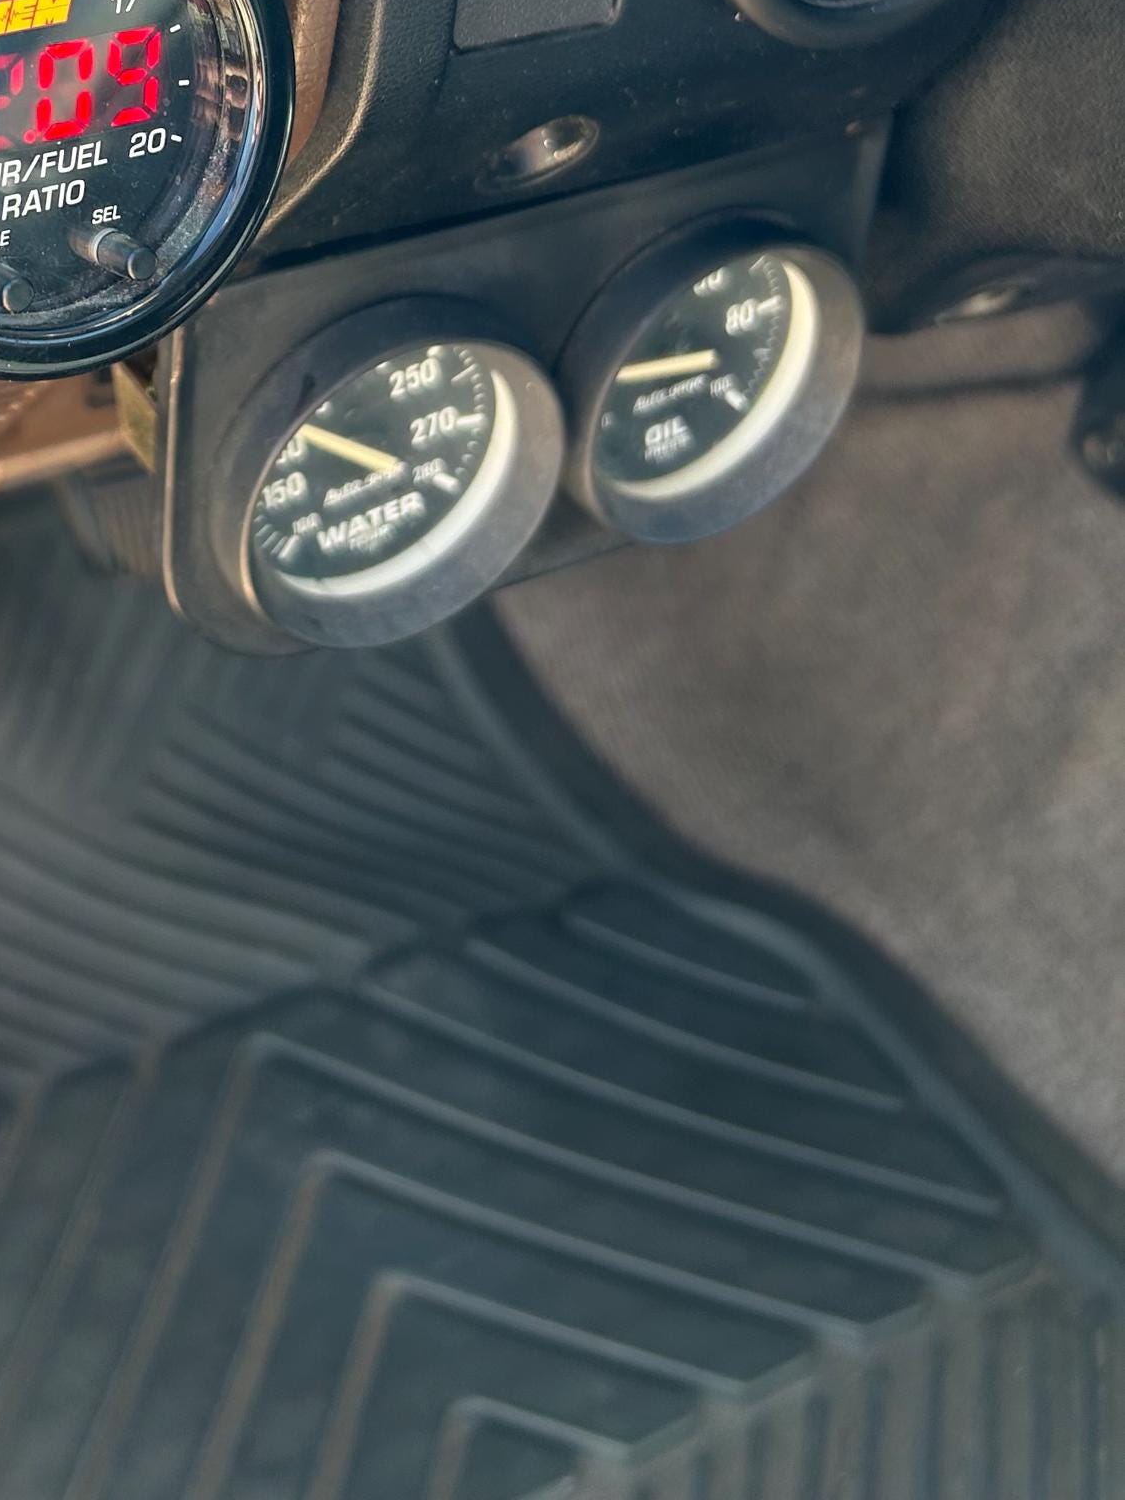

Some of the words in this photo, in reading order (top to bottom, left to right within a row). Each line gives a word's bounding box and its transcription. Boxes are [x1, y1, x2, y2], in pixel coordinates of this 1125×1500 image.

[128, 128, 166, 158] 20
[1, 180, 85, 222] RATIO
[91, 205, 121, 225] SEL
[726, 298, 757, 335] 80
[388, 357, 441, 399] 250
[409, 405, 458, 447] 270
[644, 416, 688, 446] OIL
[261, 471, 308, 508] 150
[317, 491, 425, 552] WATER
